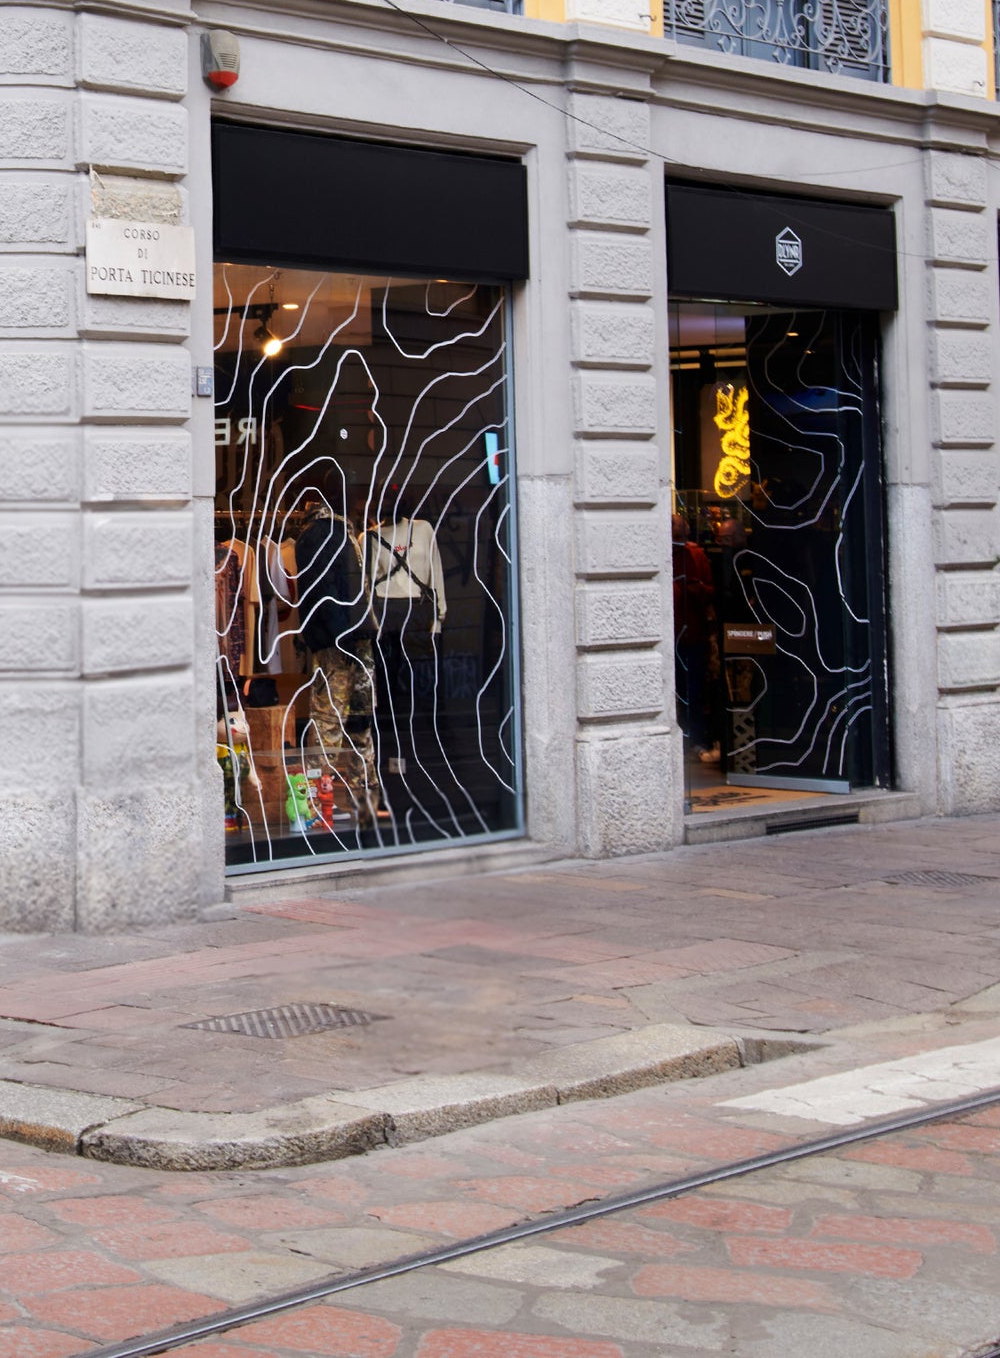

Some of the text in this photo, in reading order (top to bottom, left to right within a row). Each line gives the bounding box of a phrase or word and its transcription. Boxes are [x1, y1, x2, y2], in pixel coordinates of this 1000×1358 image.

[123, 228, 160, 241] CORSO
[137, 248, 148, 259] DI
[91, 266, 195, 287] PORTA TICINESE
